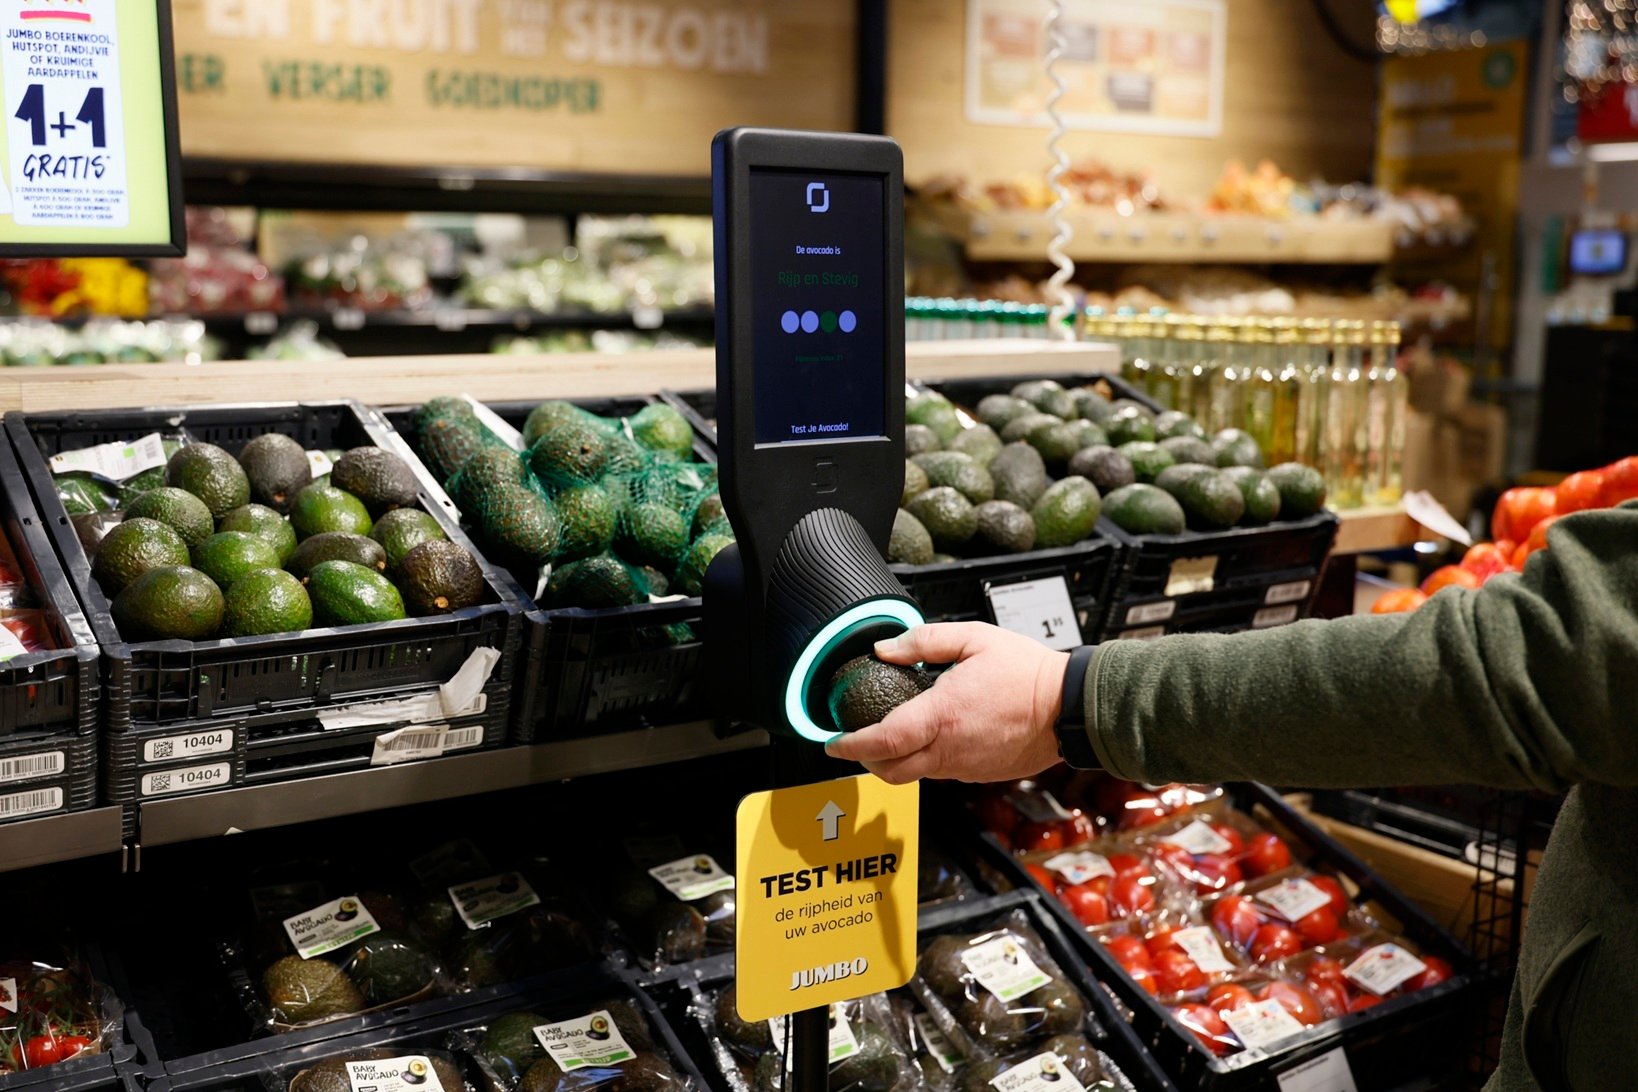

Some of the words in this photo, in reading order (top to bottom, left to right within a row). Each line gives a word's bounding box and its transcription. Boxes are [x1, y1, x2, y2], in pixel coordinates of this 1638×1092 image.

[6, 28, 42, 40] JUMBO
[311, 0, 481, 54] FRUIT
[562, 3, 769, 74] SEIZOEN
[30, 55, 42, 65] OF
[47, 56, 93, 67] KRUIMIGE
[28, 67, 98, 79] AARDAPPELEN
[15, 84, 106, 148] 1+1
[796, 245, 805, 254] De
[806, 245, 833, 254] avocado
[834, 246, 841, 255] is
[778, 271, 800, 287] Rijp
[804, 273, 819, 285] en
[822, 271, 859, 288] Stevig
[791, 425, 806, 434] Test
[808, 424, 817, 433] Je
[818, 422, 849, 432] Avocado!
[183, 734, 223, 748] 10404
[179, 768, 221, 783] 10404
[760, 865, 828, 898] TEST
[836, 853, 897, 884] HIER
[775, 908, 794, 922] de
[799, 894, 853, 919] rijpheid
[858, 890, 883, 905] van
[290, 916, 312, 930] BABY
[294, 914, 333, 936] AVOCADO
[785, 926, 807, 940] uw
[811, 910, 873, 934] avocado
[789, 957, 869, 991] JUMBO
[540, 1027, 562, 1036] BABY
[545, 1029, 584, 1041] AVOCADO
[352, 1065, 376, 1073] BABY
[356, 1069, 399, 1080] AVOCADO
